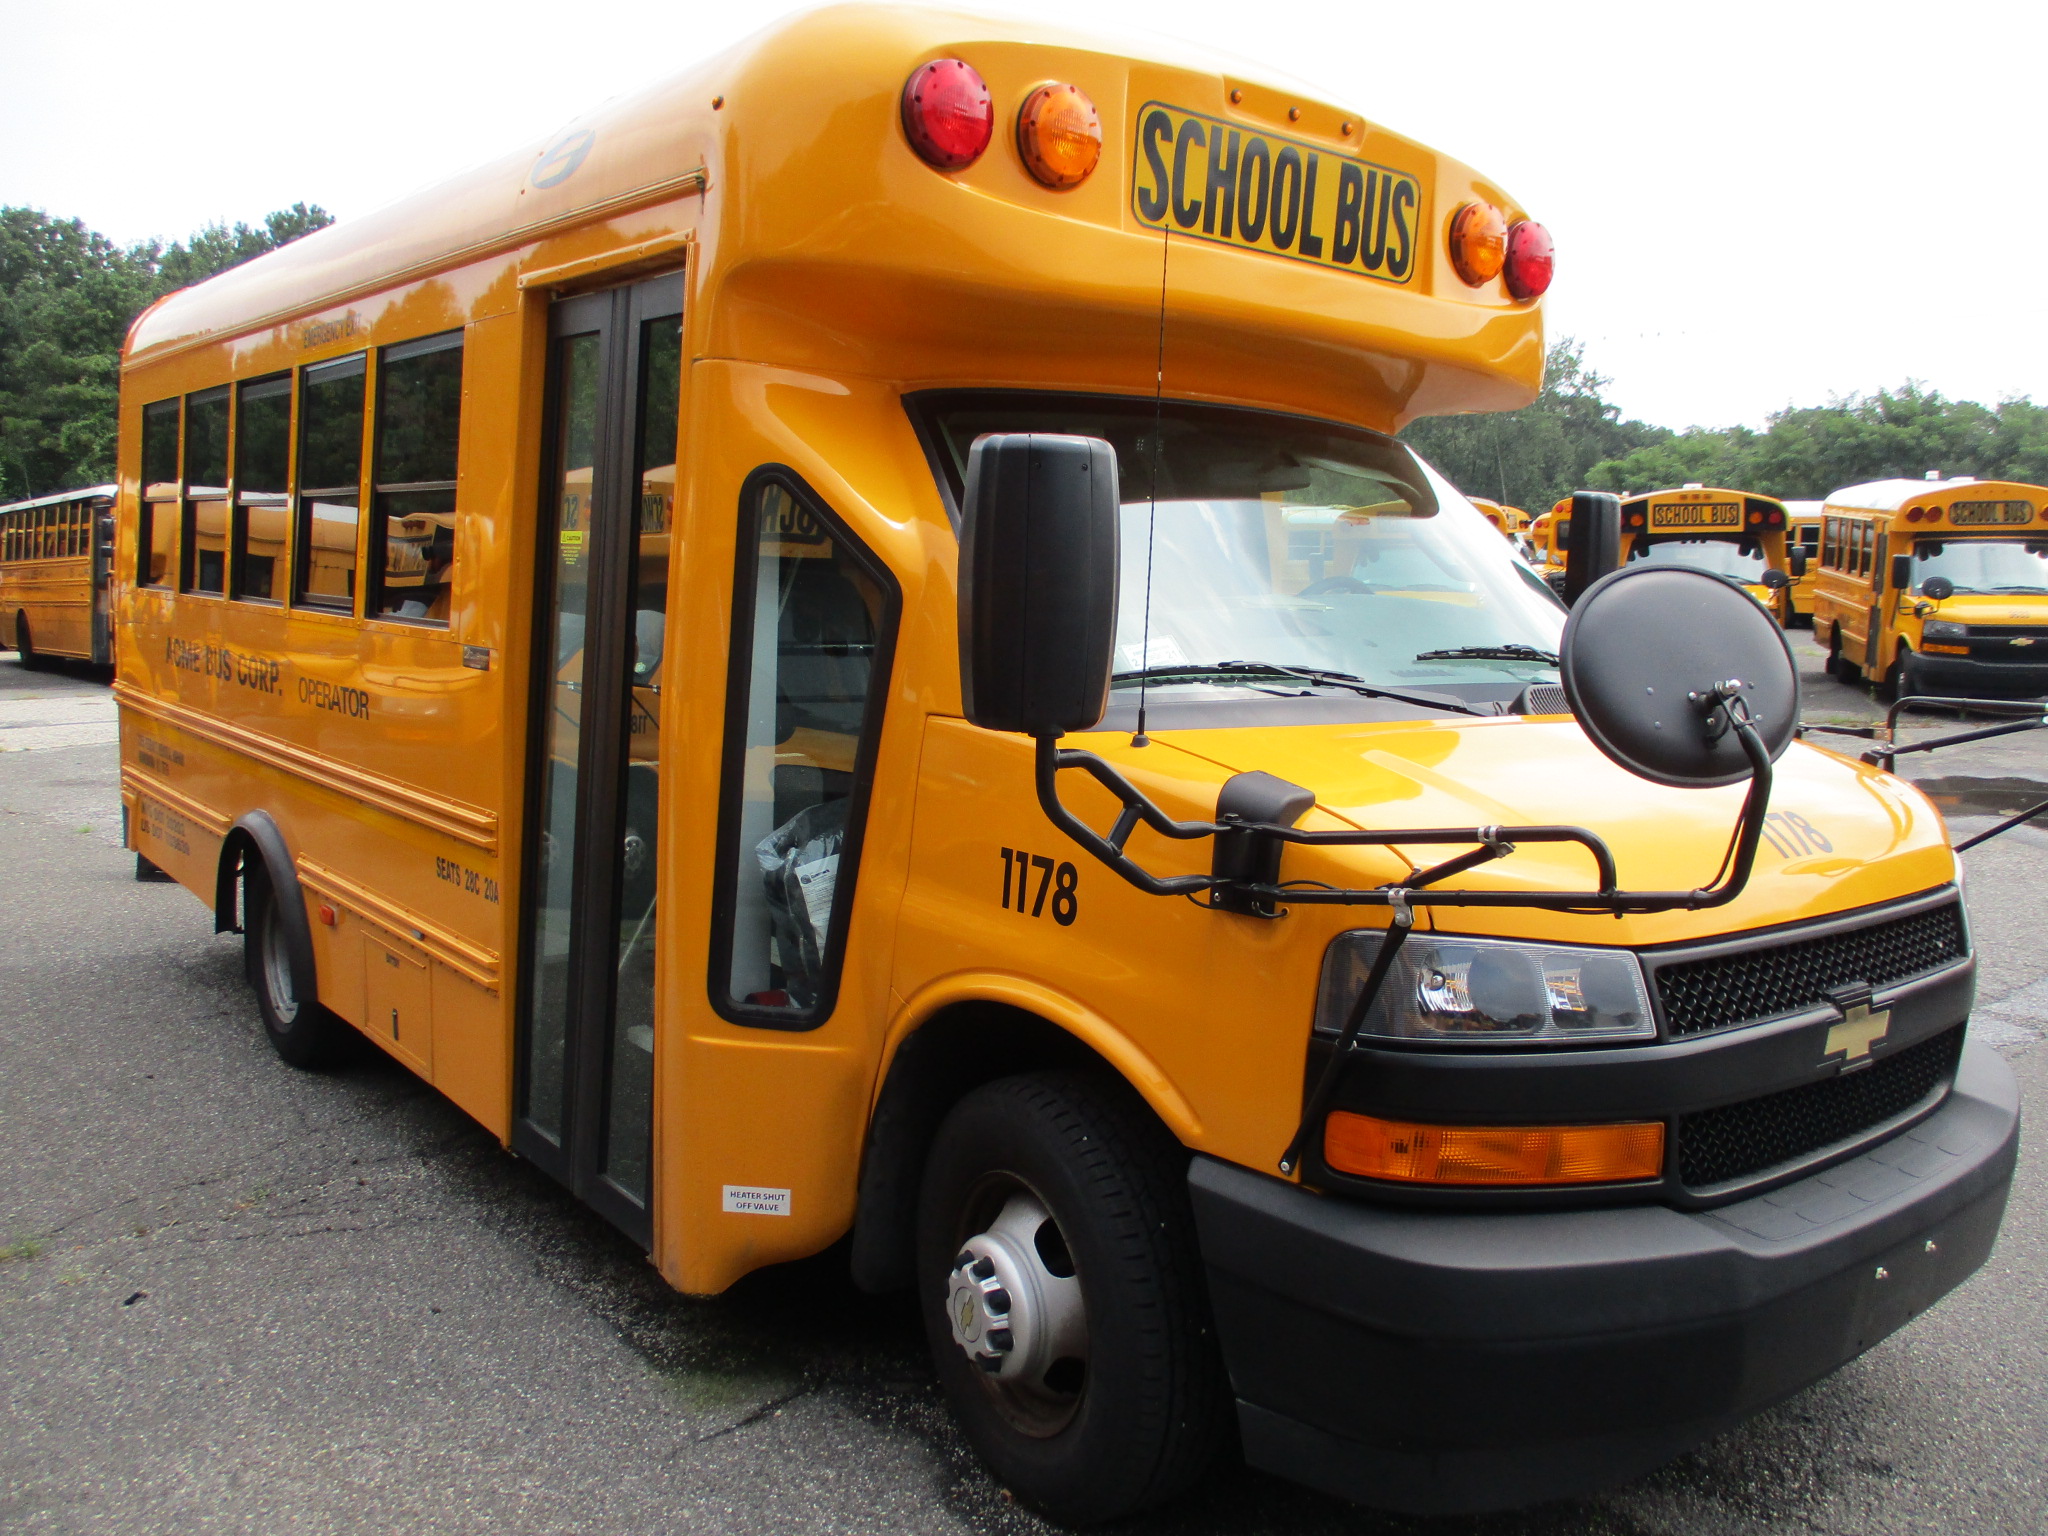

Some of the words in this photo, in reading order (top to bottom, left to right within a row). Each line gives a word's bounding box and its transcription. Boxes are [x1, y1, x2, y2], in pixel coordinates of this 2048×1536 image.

[1138, 110, 1324, 259] SCHOOL
[1332, 161, 1415, 278] BUS
[1656, 505, 1706, 524] SCHOOL
[1711, 505, 1737, 523] BUS
[166, 637, 200, 673] ACME
[205, 644, 231, 682] BUS
[237, 653, 282, 697] CORP.
[299, 677, 369, 720] OPERATOR
[436, 855, 461, 887] SEATS
[484, 876, 500, 905] 20A
[1000, 846, 1079, 927] 1178
[730, 1191, 761, 1200] HEATER
[763, 1193, 785, 1201] SHUT
[754, 1203, 779, 1211] VALVE
